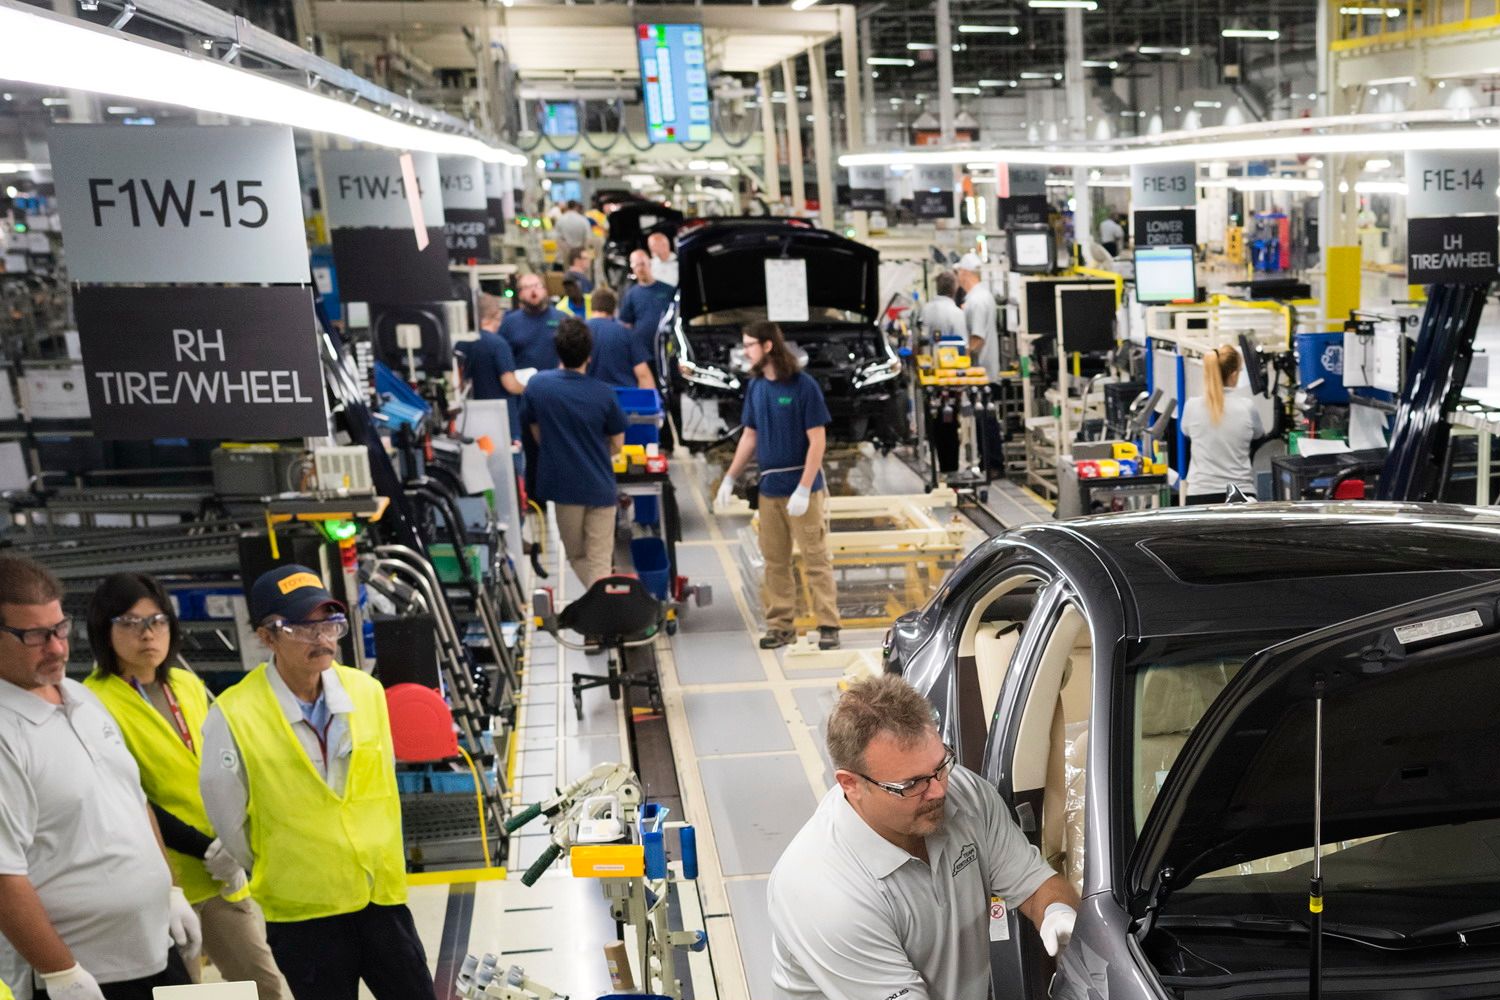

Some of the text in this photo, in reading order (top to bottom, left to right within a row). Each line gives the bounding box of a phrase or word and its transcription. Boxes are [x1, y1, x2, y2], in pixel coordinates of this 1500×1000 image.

[1143, 176, 1187, 192] F1E-13
[1424, 168, 1484, 192] F1E-14
[88, 178, 268, 228] F1W-15
[1146, 220, 1184, 233] LOWER
[1444, 234, 1462, 250] LH
[1411, 252, 1494, 270] TIRE/WHEEL
[173, 329, 225, 362] RH
[95, 370, 312, 404] TIRE/WHEEL
